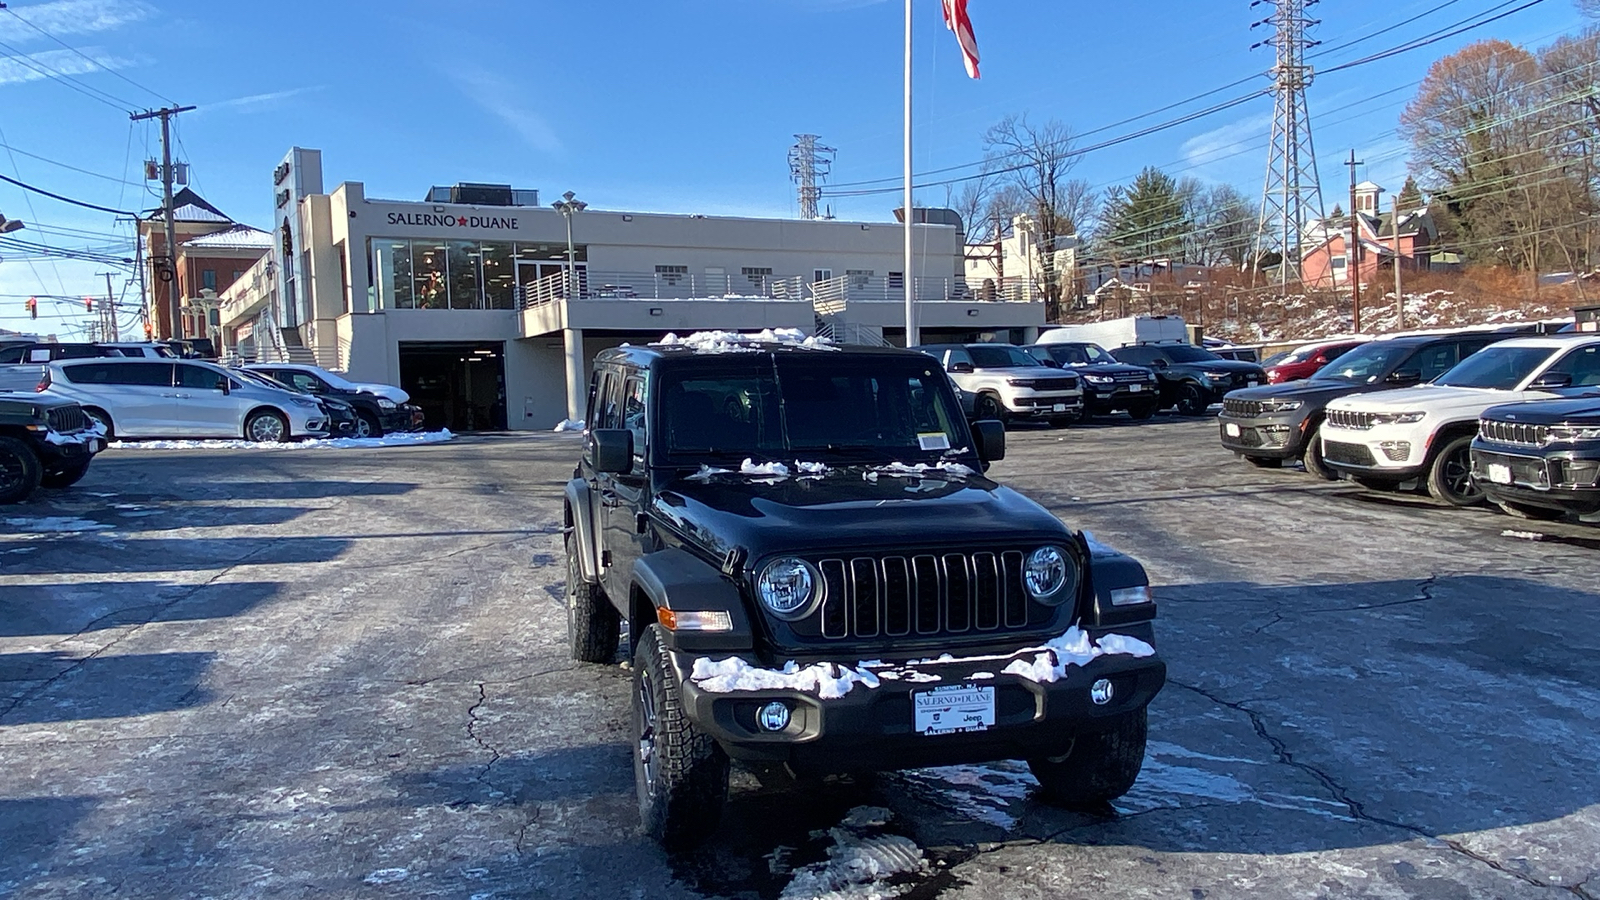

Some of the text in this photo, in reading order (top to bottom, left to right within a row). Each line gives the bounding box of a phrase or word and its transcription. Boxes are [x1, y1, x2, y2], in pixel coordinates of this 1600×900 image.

[387, 213, 519, 230] SALERNO DUANE
[917, 693, 992, 706] SALERNO DUANE
[963, 714, 982, 722] Jeep
[924, 728, 956, 736] SALERNO
